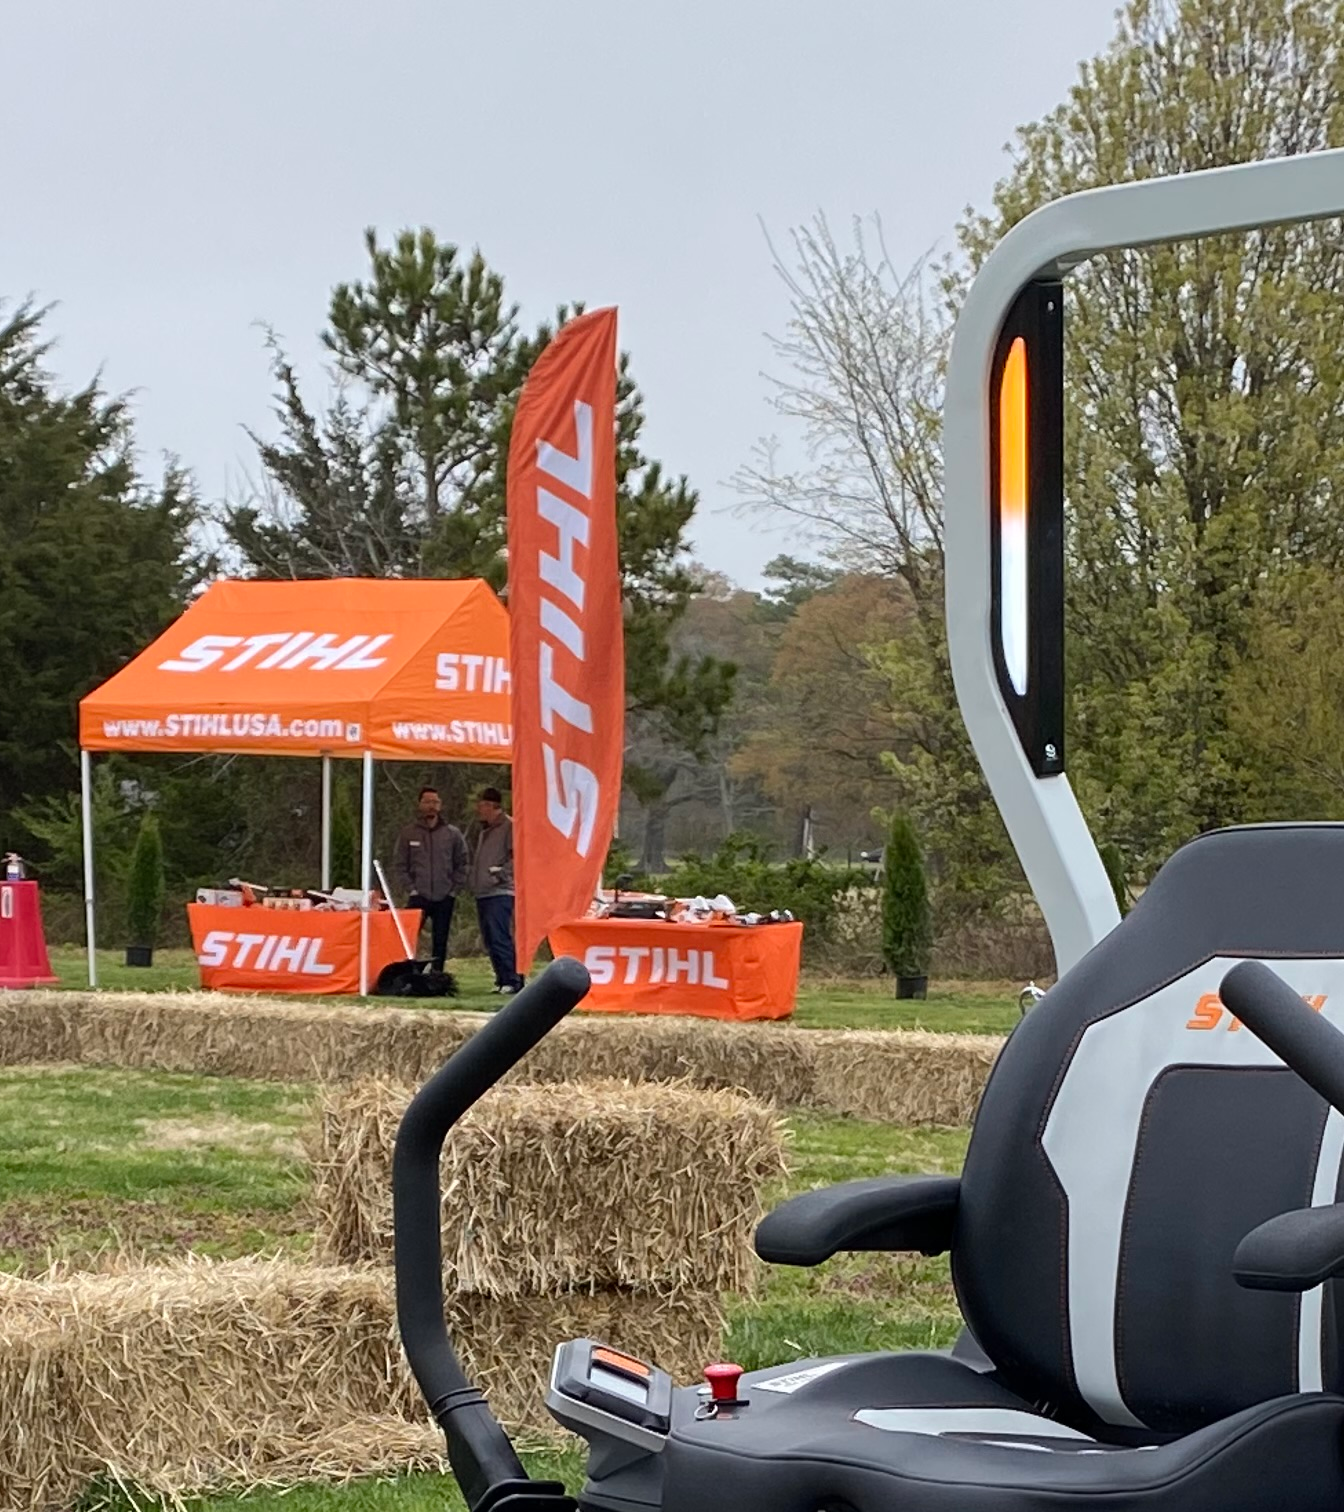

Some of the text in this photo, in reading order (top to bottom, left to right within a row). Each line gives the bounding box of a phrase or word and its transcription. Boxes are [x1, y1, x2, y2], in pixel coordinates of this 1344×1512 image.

[536, 400, 599, 858] STIHL
[157, 631, 394, 672] STIHL
[435, 653, 513, 695] STIH
[103, 713, 344, 738] www.STIHLUSA.com
[197, 930, 336, 975] STIHL
[584, 945, 730, 991] STIHL
